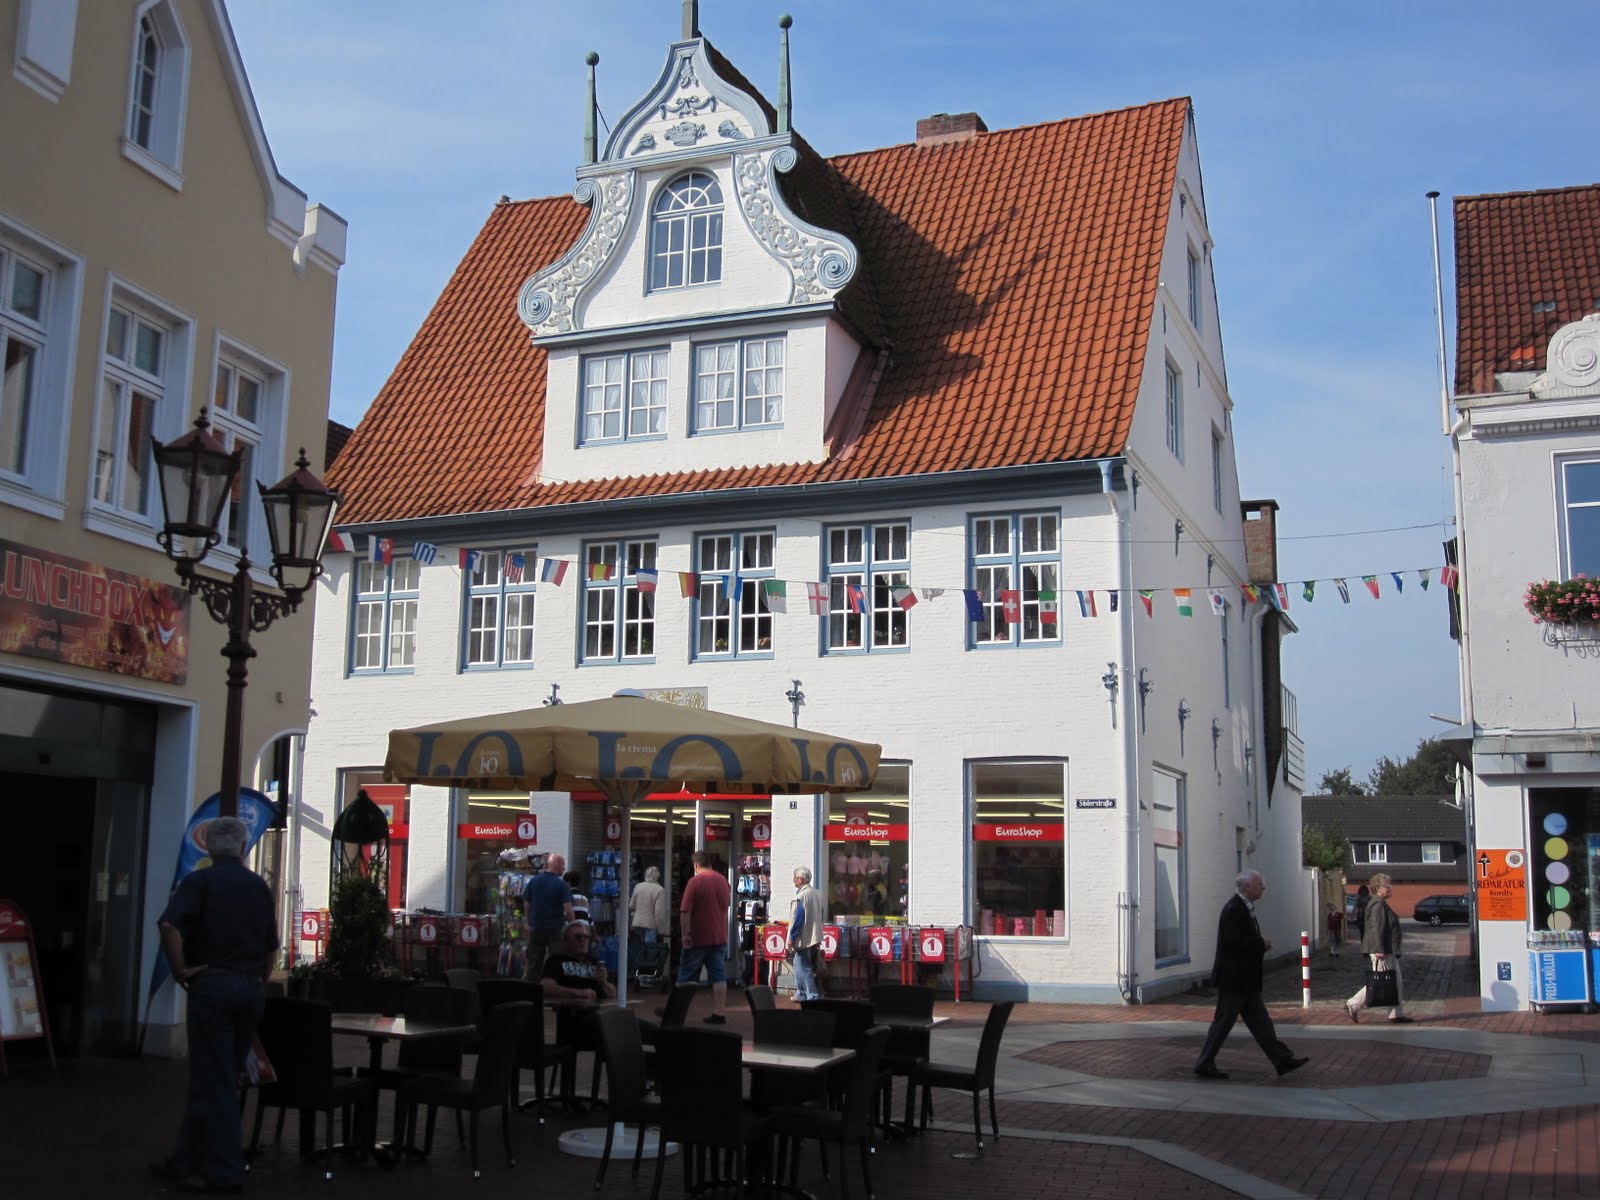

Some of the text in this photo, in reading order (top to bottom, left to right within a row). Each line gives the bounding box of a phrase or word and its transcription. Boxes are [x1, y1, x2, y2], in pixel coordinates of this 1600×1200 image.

[0, 550, 148, 627] UNCHBOX
[770, 936, 777, 948] 1
[876, 938, 883, 950] 1
[928, 938, 935, 951] 1
